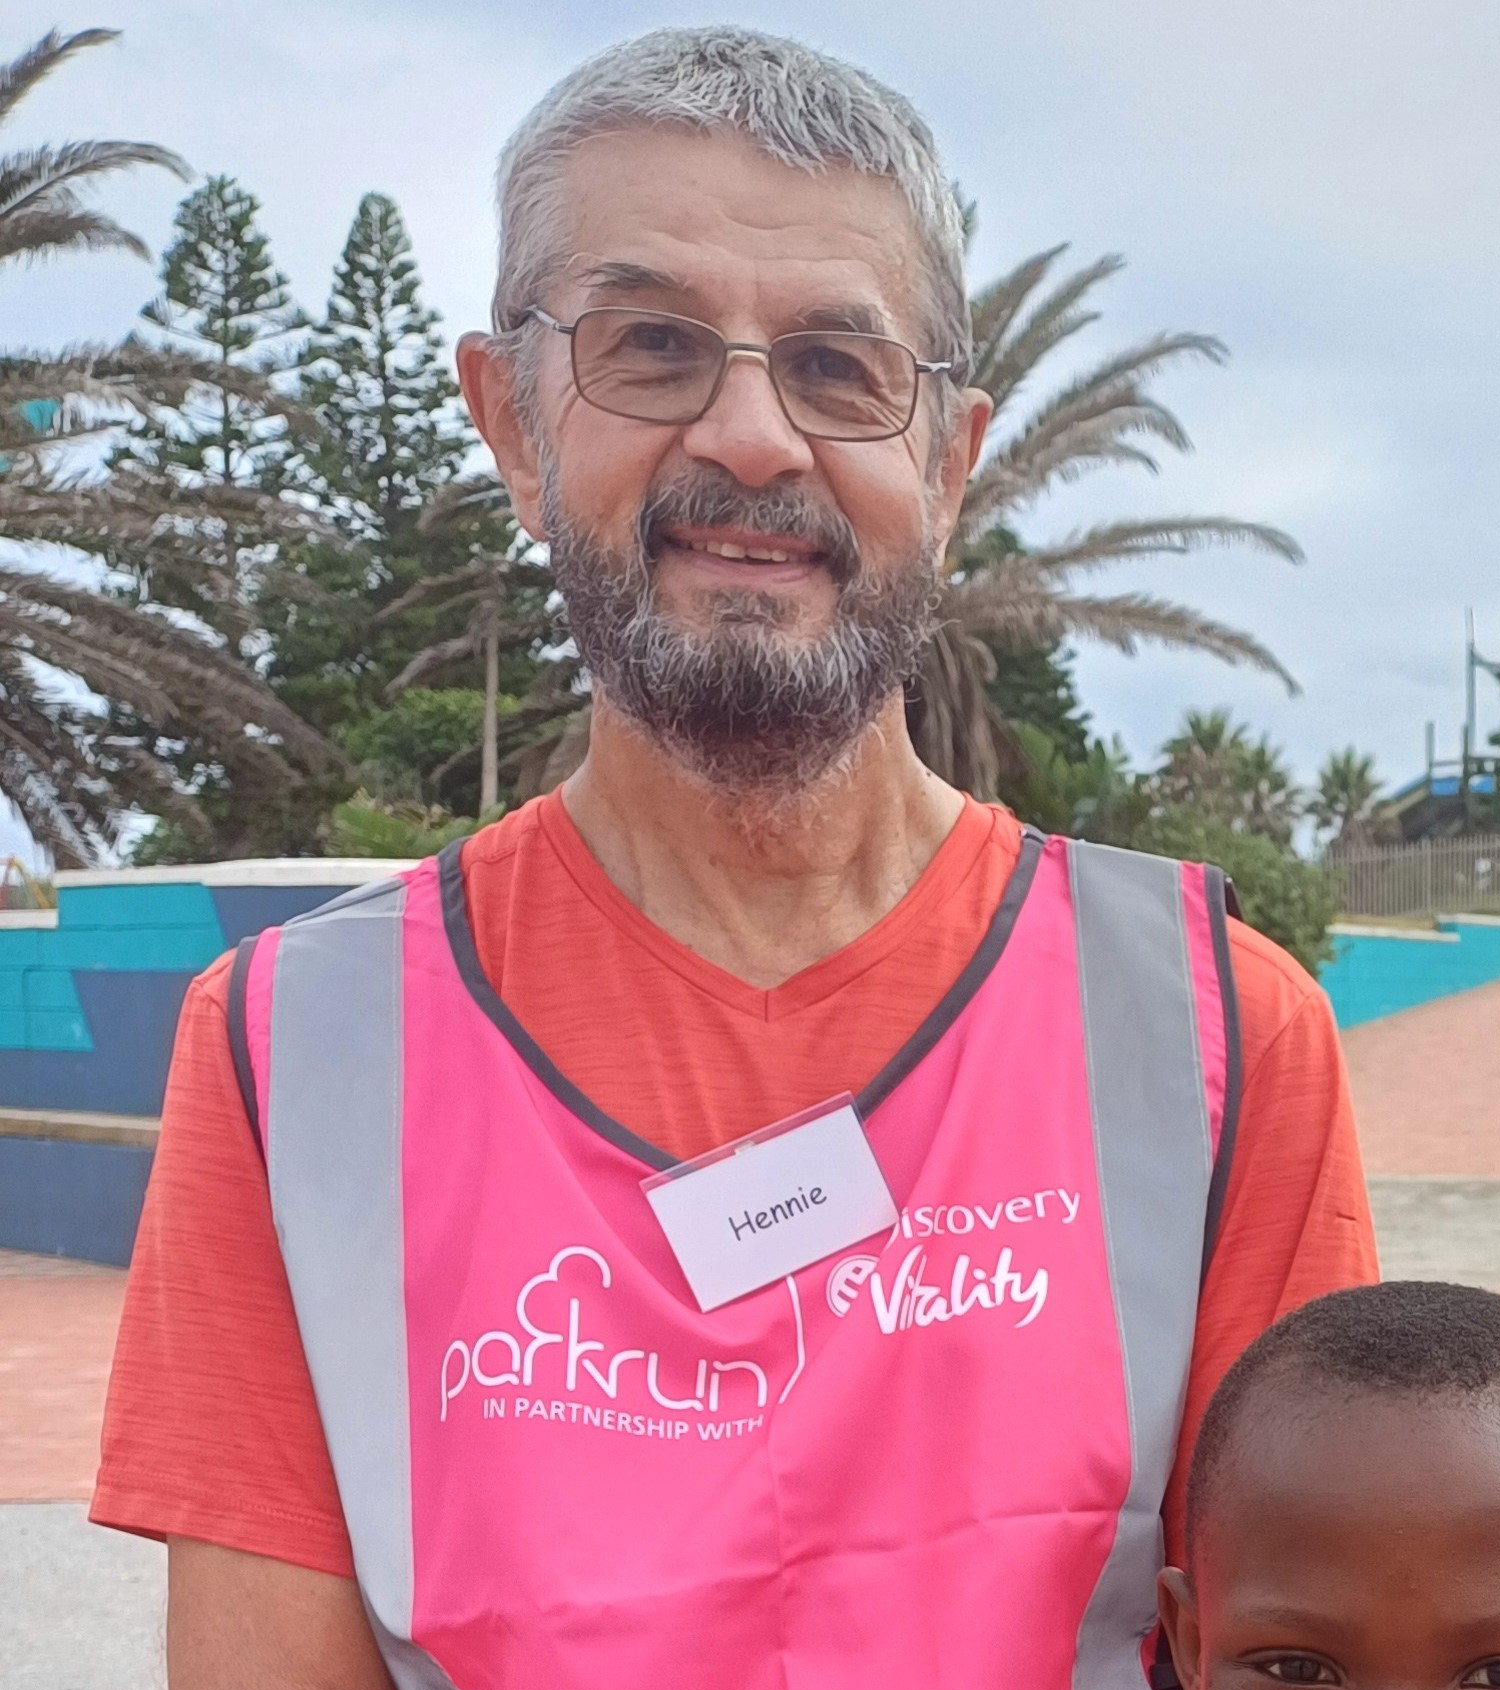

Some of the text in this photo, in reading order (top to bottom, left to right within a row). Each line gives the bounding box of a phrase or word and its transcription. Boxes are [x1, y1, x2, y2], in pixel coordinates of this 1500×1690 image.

[727, 1186, 829, 1242] Hennie
[883, 1187, 1081, 1251] iscovery
[870, 1244, 1050, 1336] Vitality
[440, 1246, 768, 1421] parkrun
[482, 1398, 765, 1441] IN PARTNERSHIP WITH
